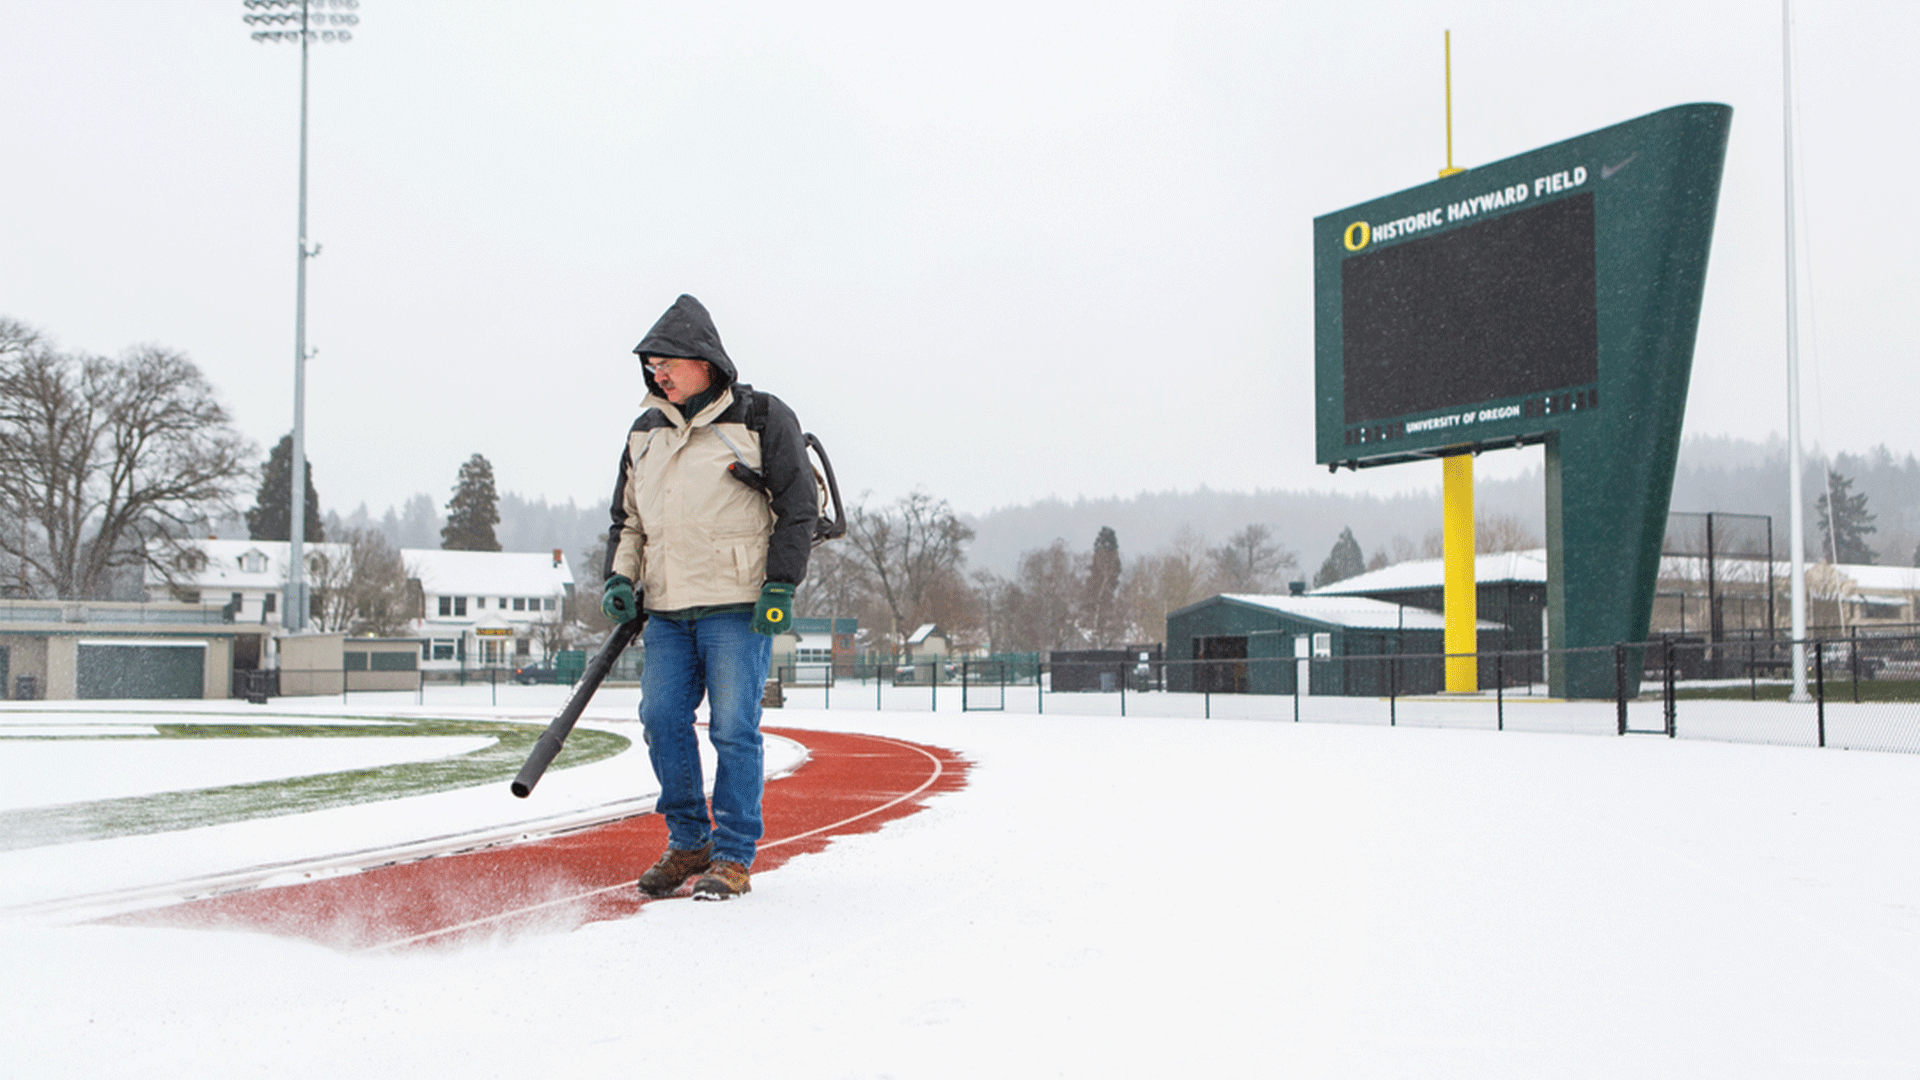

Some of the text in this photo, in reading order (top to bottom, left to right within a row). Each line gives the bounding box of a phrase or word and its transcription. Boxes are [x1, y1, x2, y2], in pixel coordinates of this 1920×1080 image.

[1344, 166, 1588, 251] O HISTORIC HAYWARD FIELD
[1406, 405, 1521, 433] UNIVERSITY OF OREGON
[765, 607, 784, 623] O
